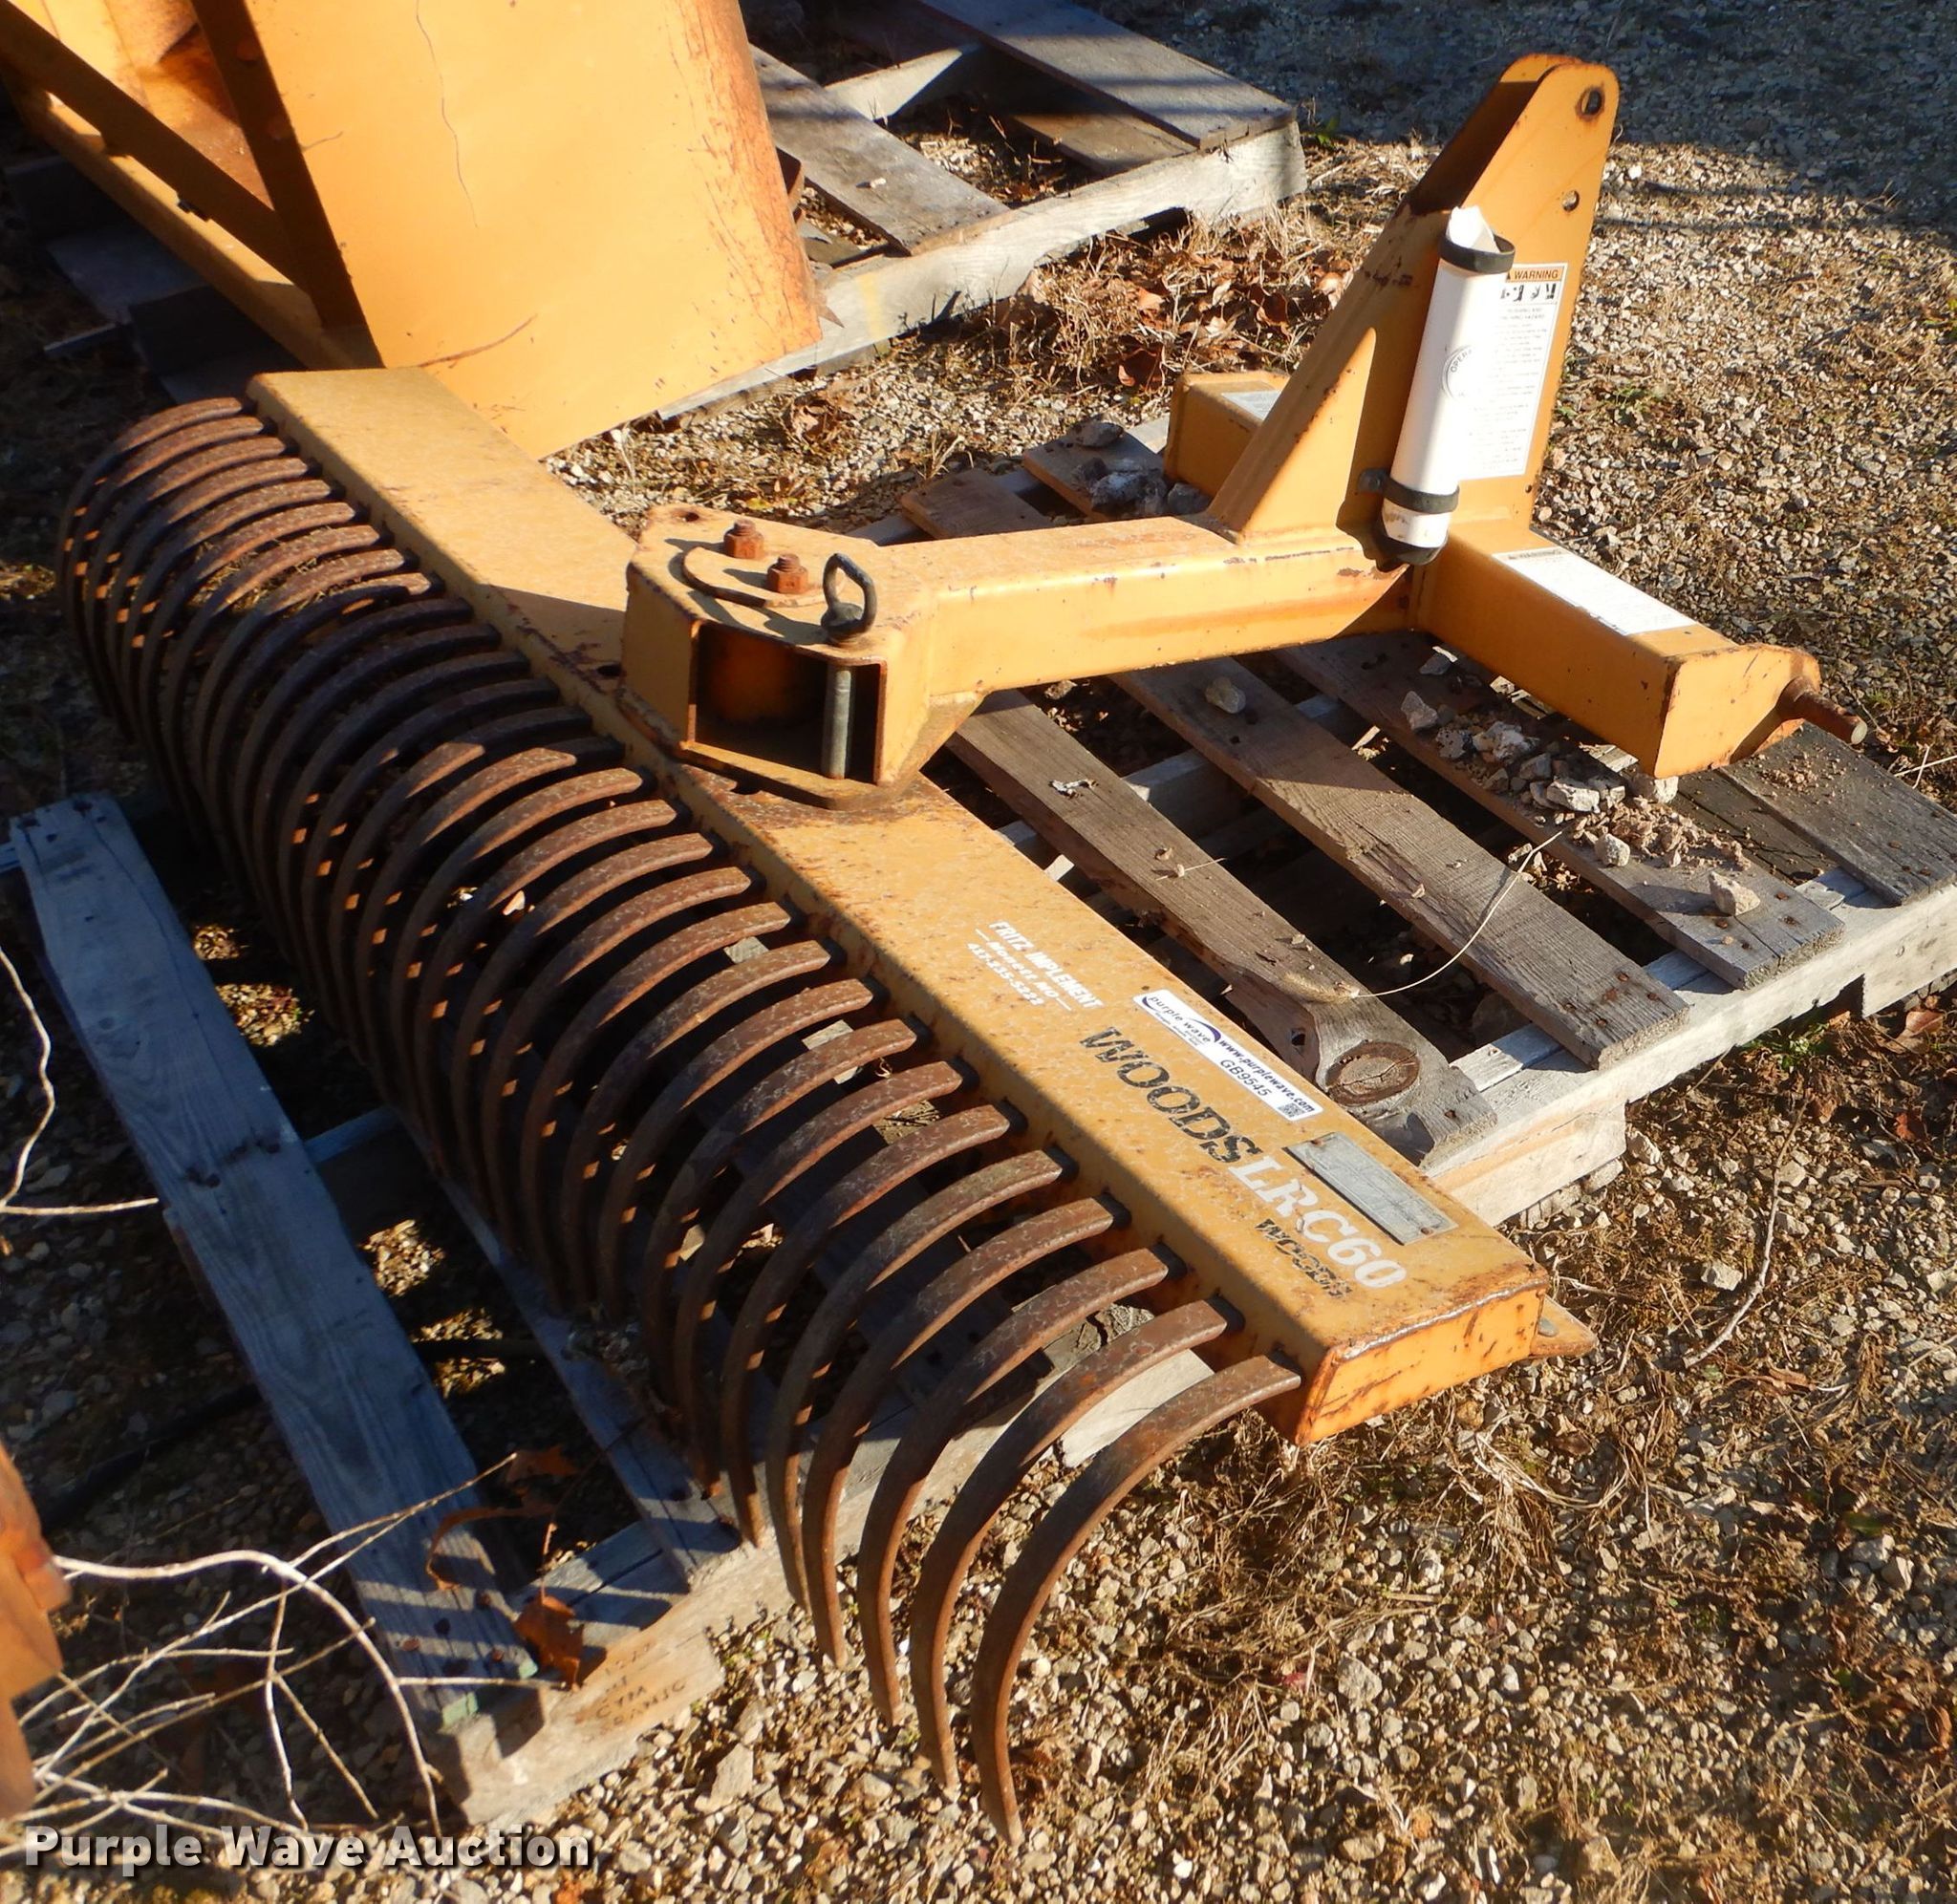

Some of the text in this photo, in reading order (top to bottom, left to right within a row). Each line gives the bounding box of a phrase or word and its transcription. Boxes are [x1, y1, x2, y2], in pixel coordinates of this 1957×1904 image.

[1514, 268, 1559, 280] WARNING
[989, 921, 1105, 1009] FRITZ IMPLEMENT
[1148, 996, 1183, 1021] purple
[1183, 1022, 1211, 1043] wave
[1218, 1039, 1316, 1113] www.purplewave.com
[1220, 1059, 1272, 1097] GB9545
[1080, 1026, 1263, 1164] WOODS
[1228, 1155, 1407, 1289] LRC60
